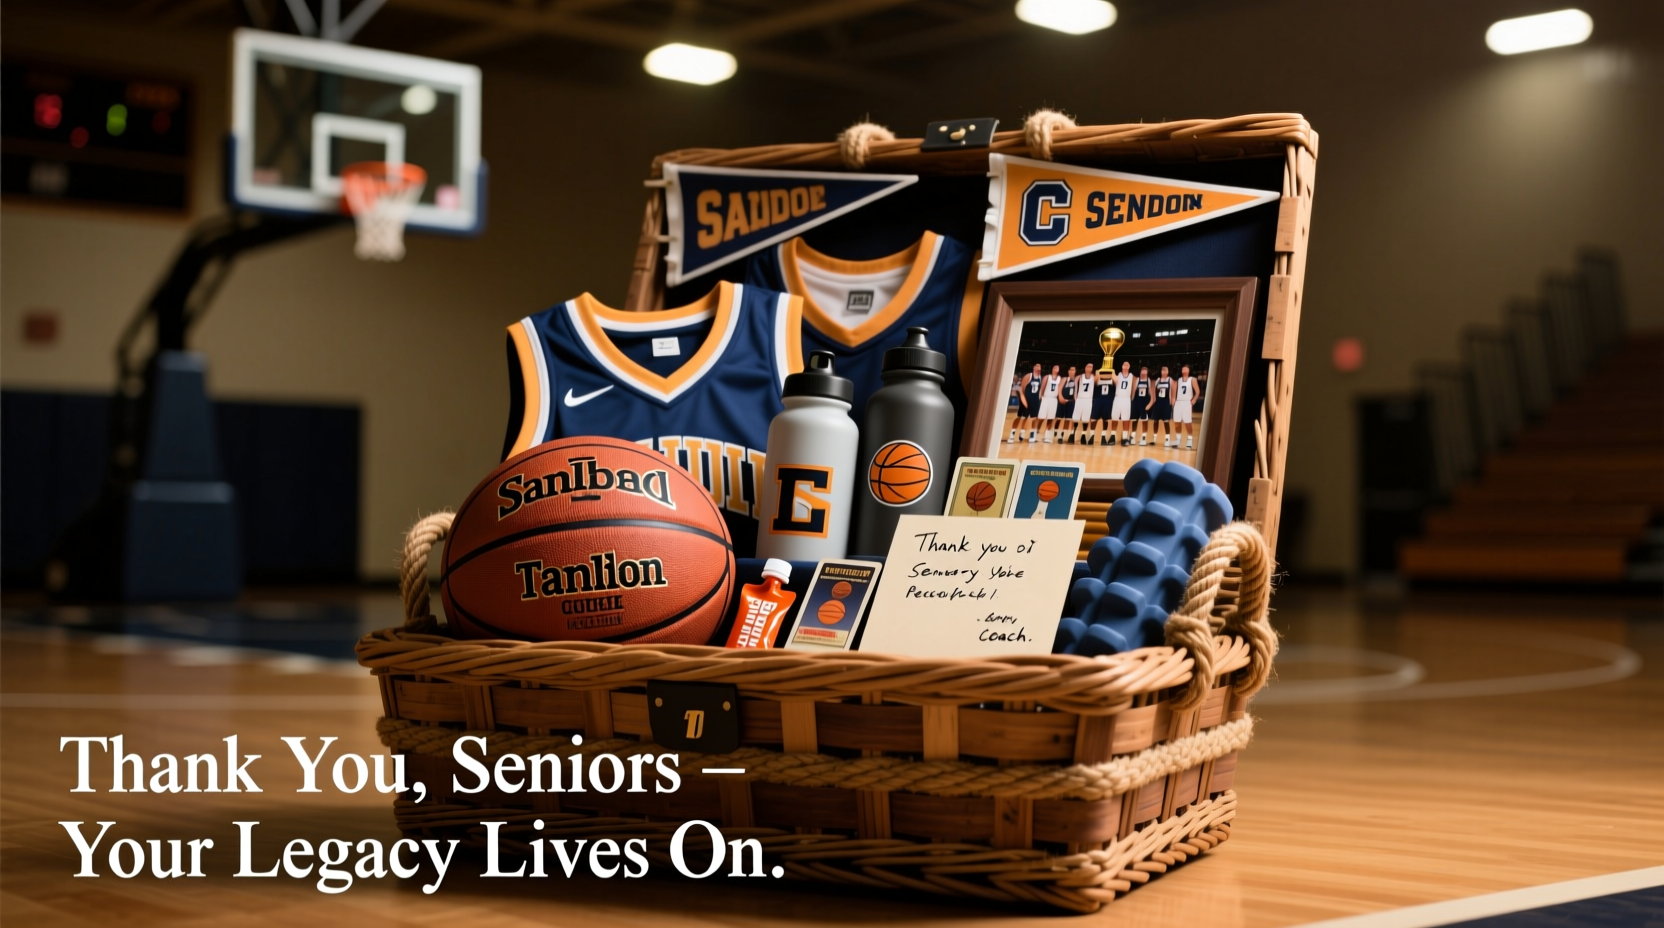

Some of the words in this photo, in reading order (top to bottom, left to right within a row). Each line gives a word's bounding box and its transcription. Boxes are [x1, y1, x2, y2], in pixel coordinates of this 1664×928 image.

[1018, 179, 1073, 246] C
[914, 532, 971, 552] Thank
[977, 543, 1007, 562] you
